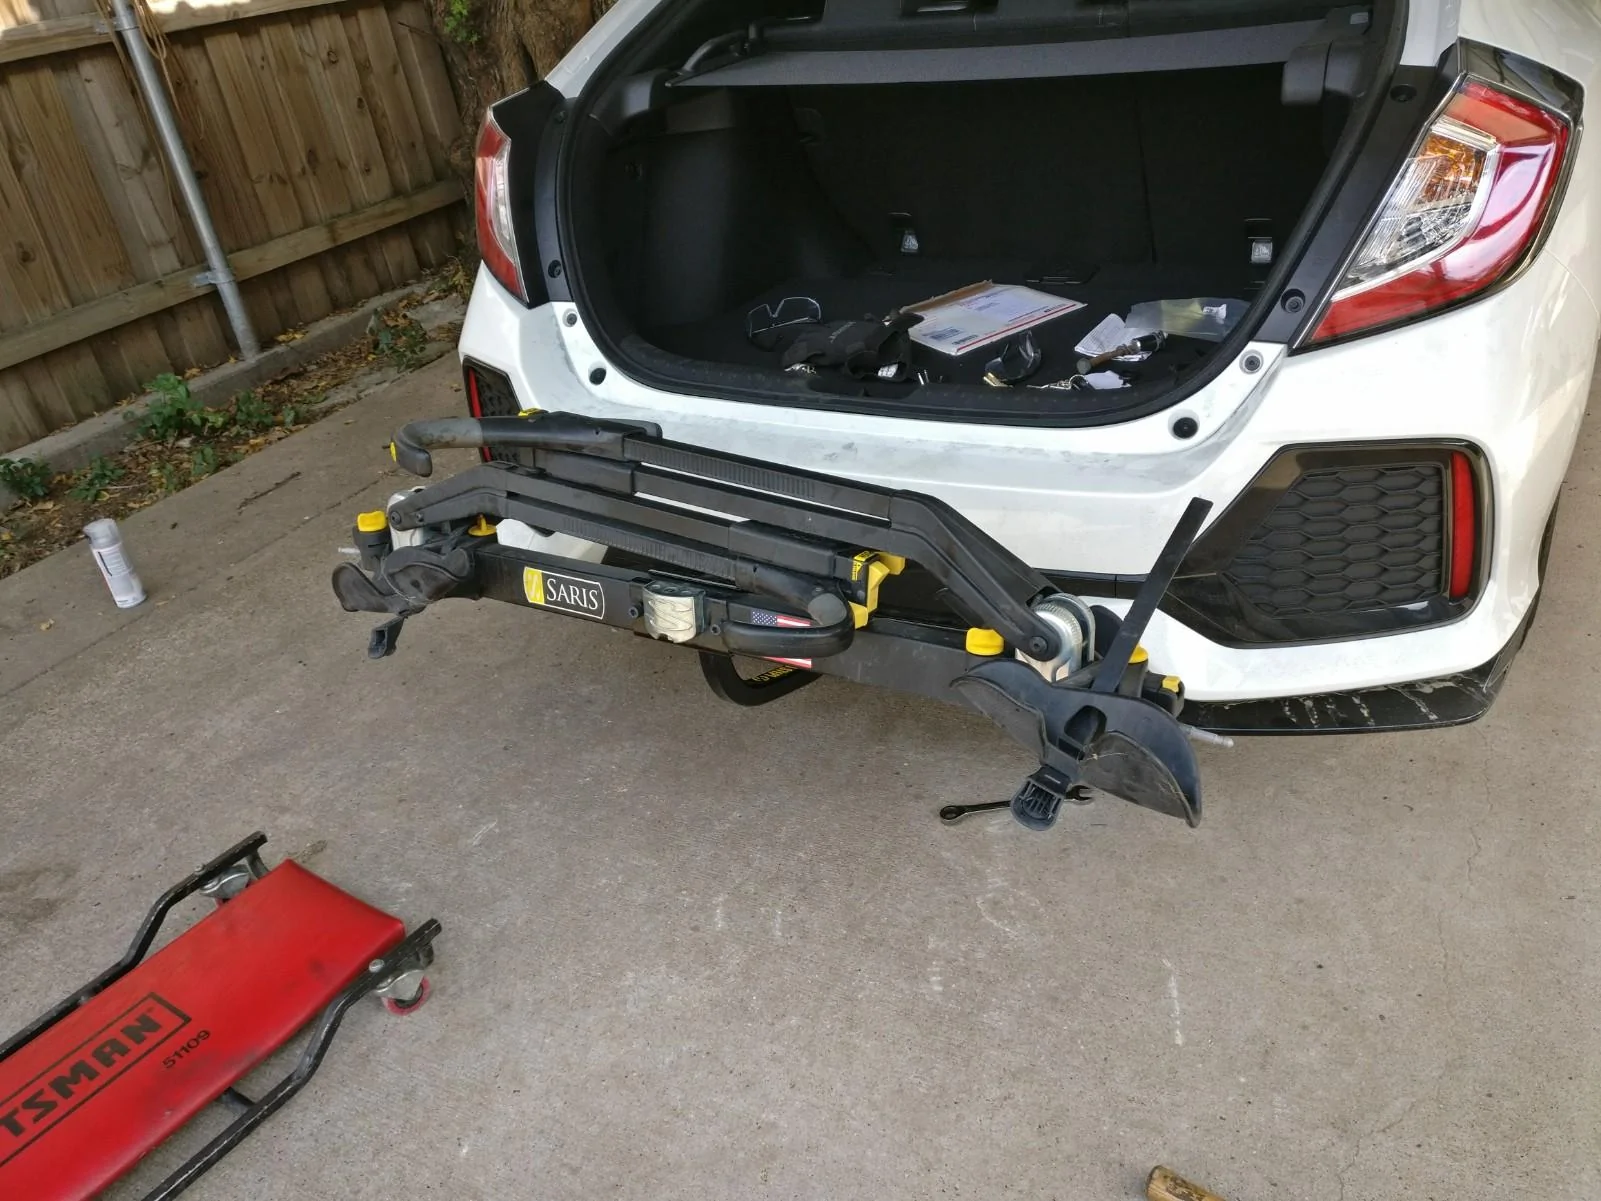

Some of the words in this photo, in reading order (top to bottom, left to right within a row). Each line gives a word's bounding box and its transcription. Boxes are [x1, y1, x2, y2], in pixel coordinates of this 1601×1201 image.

[546, 578, 598, 610] SARIS
[162, 1029, 211, 1069] 51109
[0, 1013, 162, 1137] TSMAN
